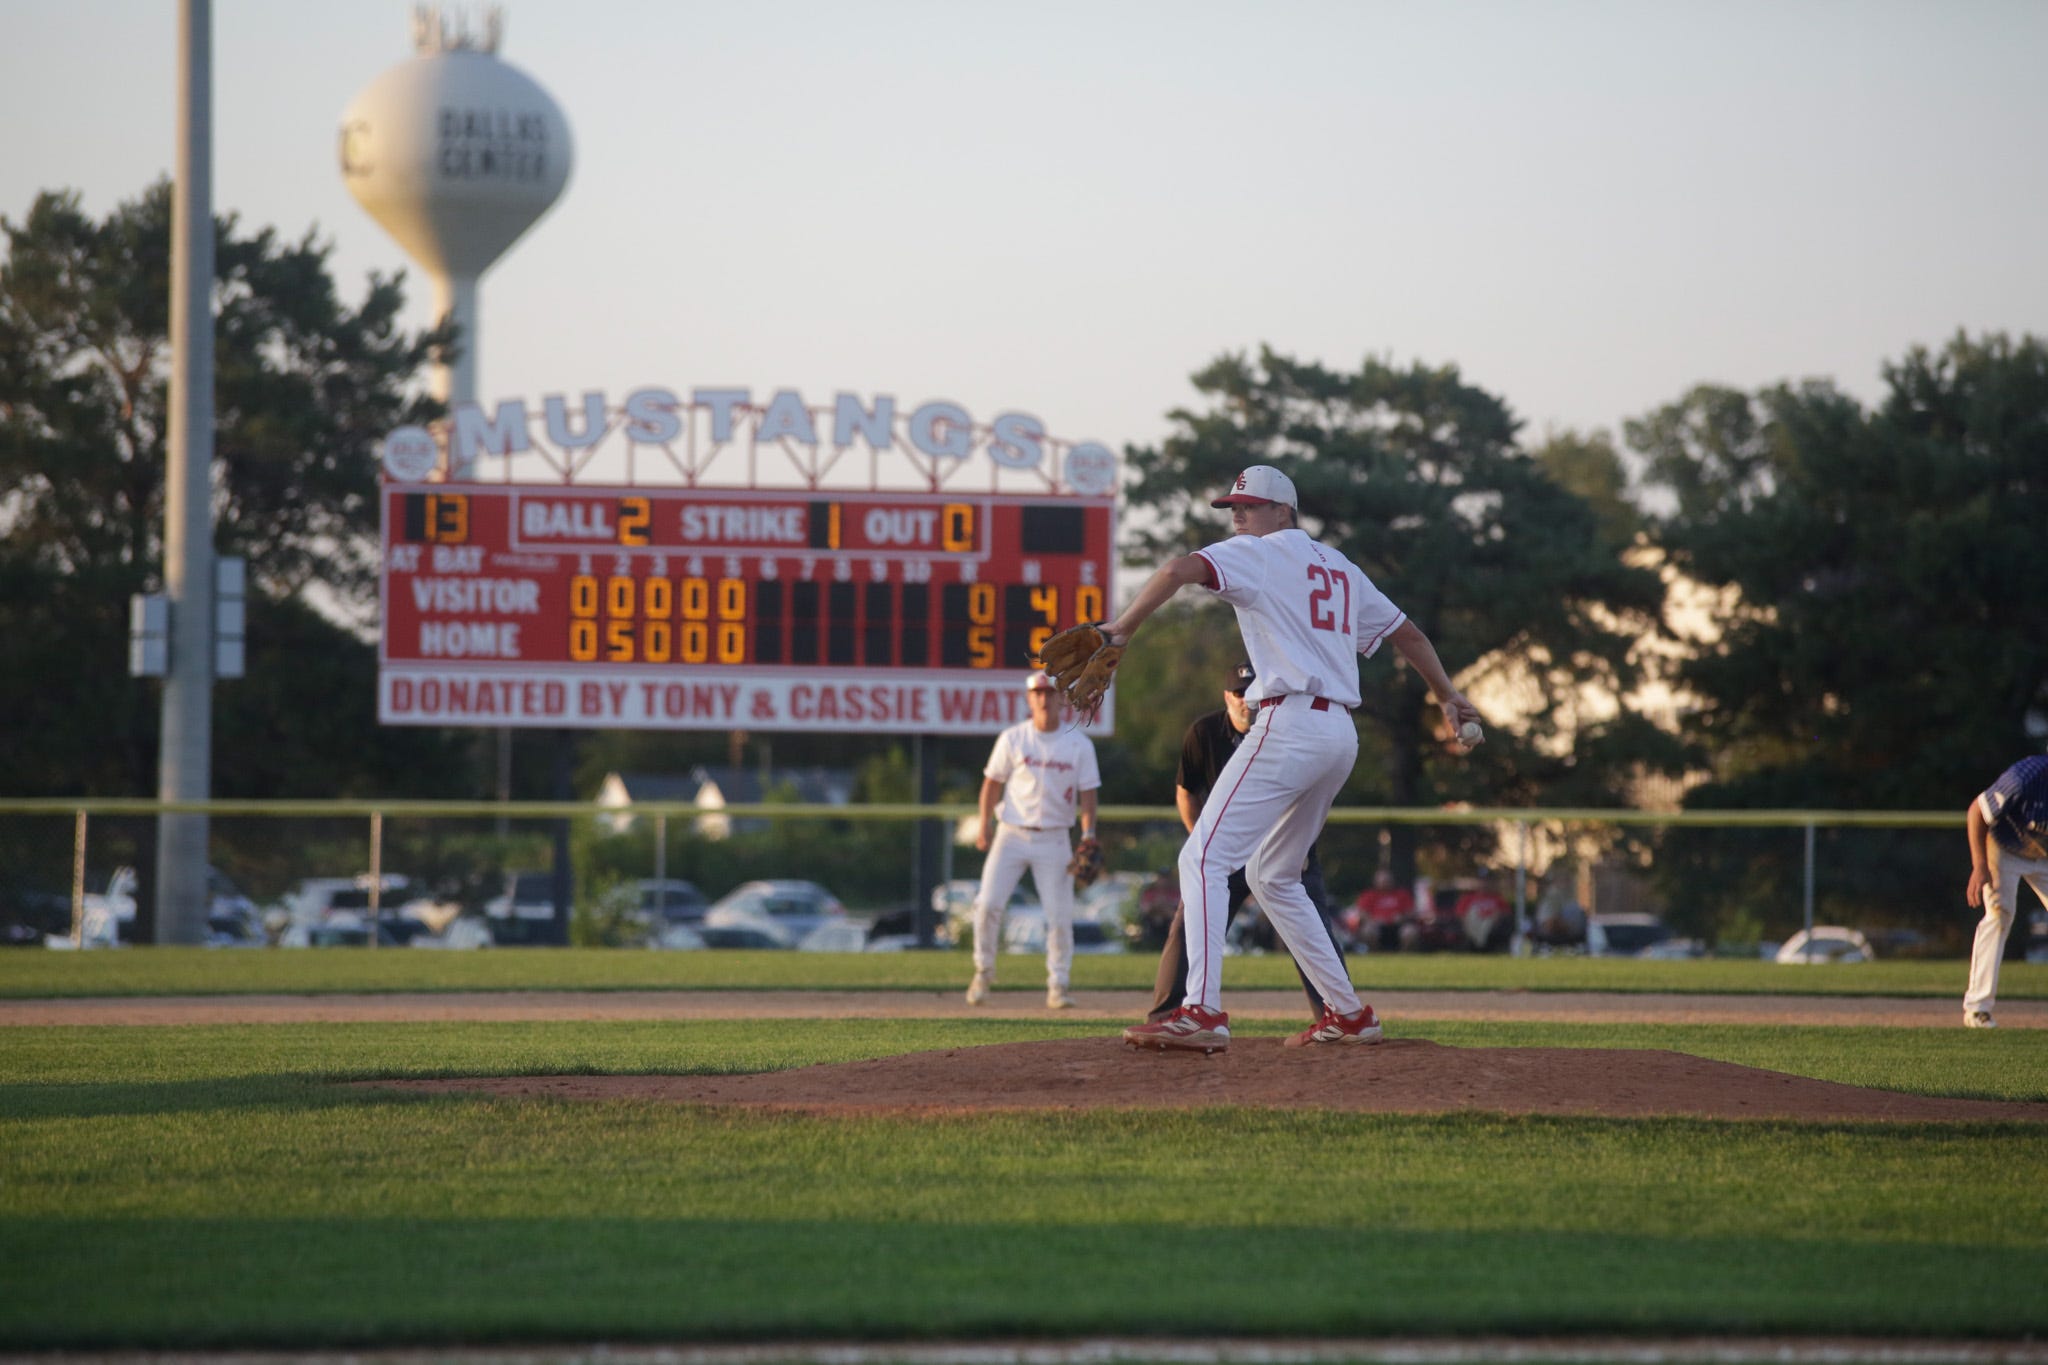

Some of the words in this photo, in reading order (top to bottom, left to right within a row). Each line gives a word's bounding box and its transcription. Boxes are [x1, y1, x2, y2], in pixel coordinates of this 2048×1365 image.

[439, 107, 546, 142] DALLAS
[454, 389, 1045, 469] MUSTANGS
[425, 493, 469, 543] 13
[522, 502, 613, 538] BALL
[618, 496, 650, 546] 2
[681, 505, 806, 542] STRIKE
[828, 503, 841, 551] 1
[864, 508, 937, 544] OUT
[942, 502, 974, 552] 0
[391, 544, 420, 572] AT
[432, 544, 484, 573] BAT
[578, 553, 592, 576] 1
[616, 553, 631, 576] 2
[653, 553, 669, 577] 3
[686, 554, 704, 577] 4
[760, 556, 778, 580] 6
[411, 577, 540, 613] VISITOR
[570, 575, 598, 619] 0
[607, 575, 635, 620] 0
[644, 576, 672, 620] 0
[681, 577, 709, 621] 0
[718, 577, 746, 622] 0
[968, 583, 995, 625] 0
[1030, 584, 1058, 626] 4
[1075, 584, 1102, 624] 0
[1307, 562, 1351, 636] 27
[419, 621, 521, 657] HOME
[569, 619, 598, 662] 0
[607, 620, 635, 663] 5
[644, 620, 672, 663] 0
[681, 621, 708, 664] 0
[718, 621, 745, 665] 0
[967, 626, 995, 669] 5
[390, 678, 566, 717] DONATED
[578, 680, 628, 717] BY
[639, 681, 741, 720] TONY
[751, 691, 776, 721] &
[788, 684, 929, 723] CASSIE
